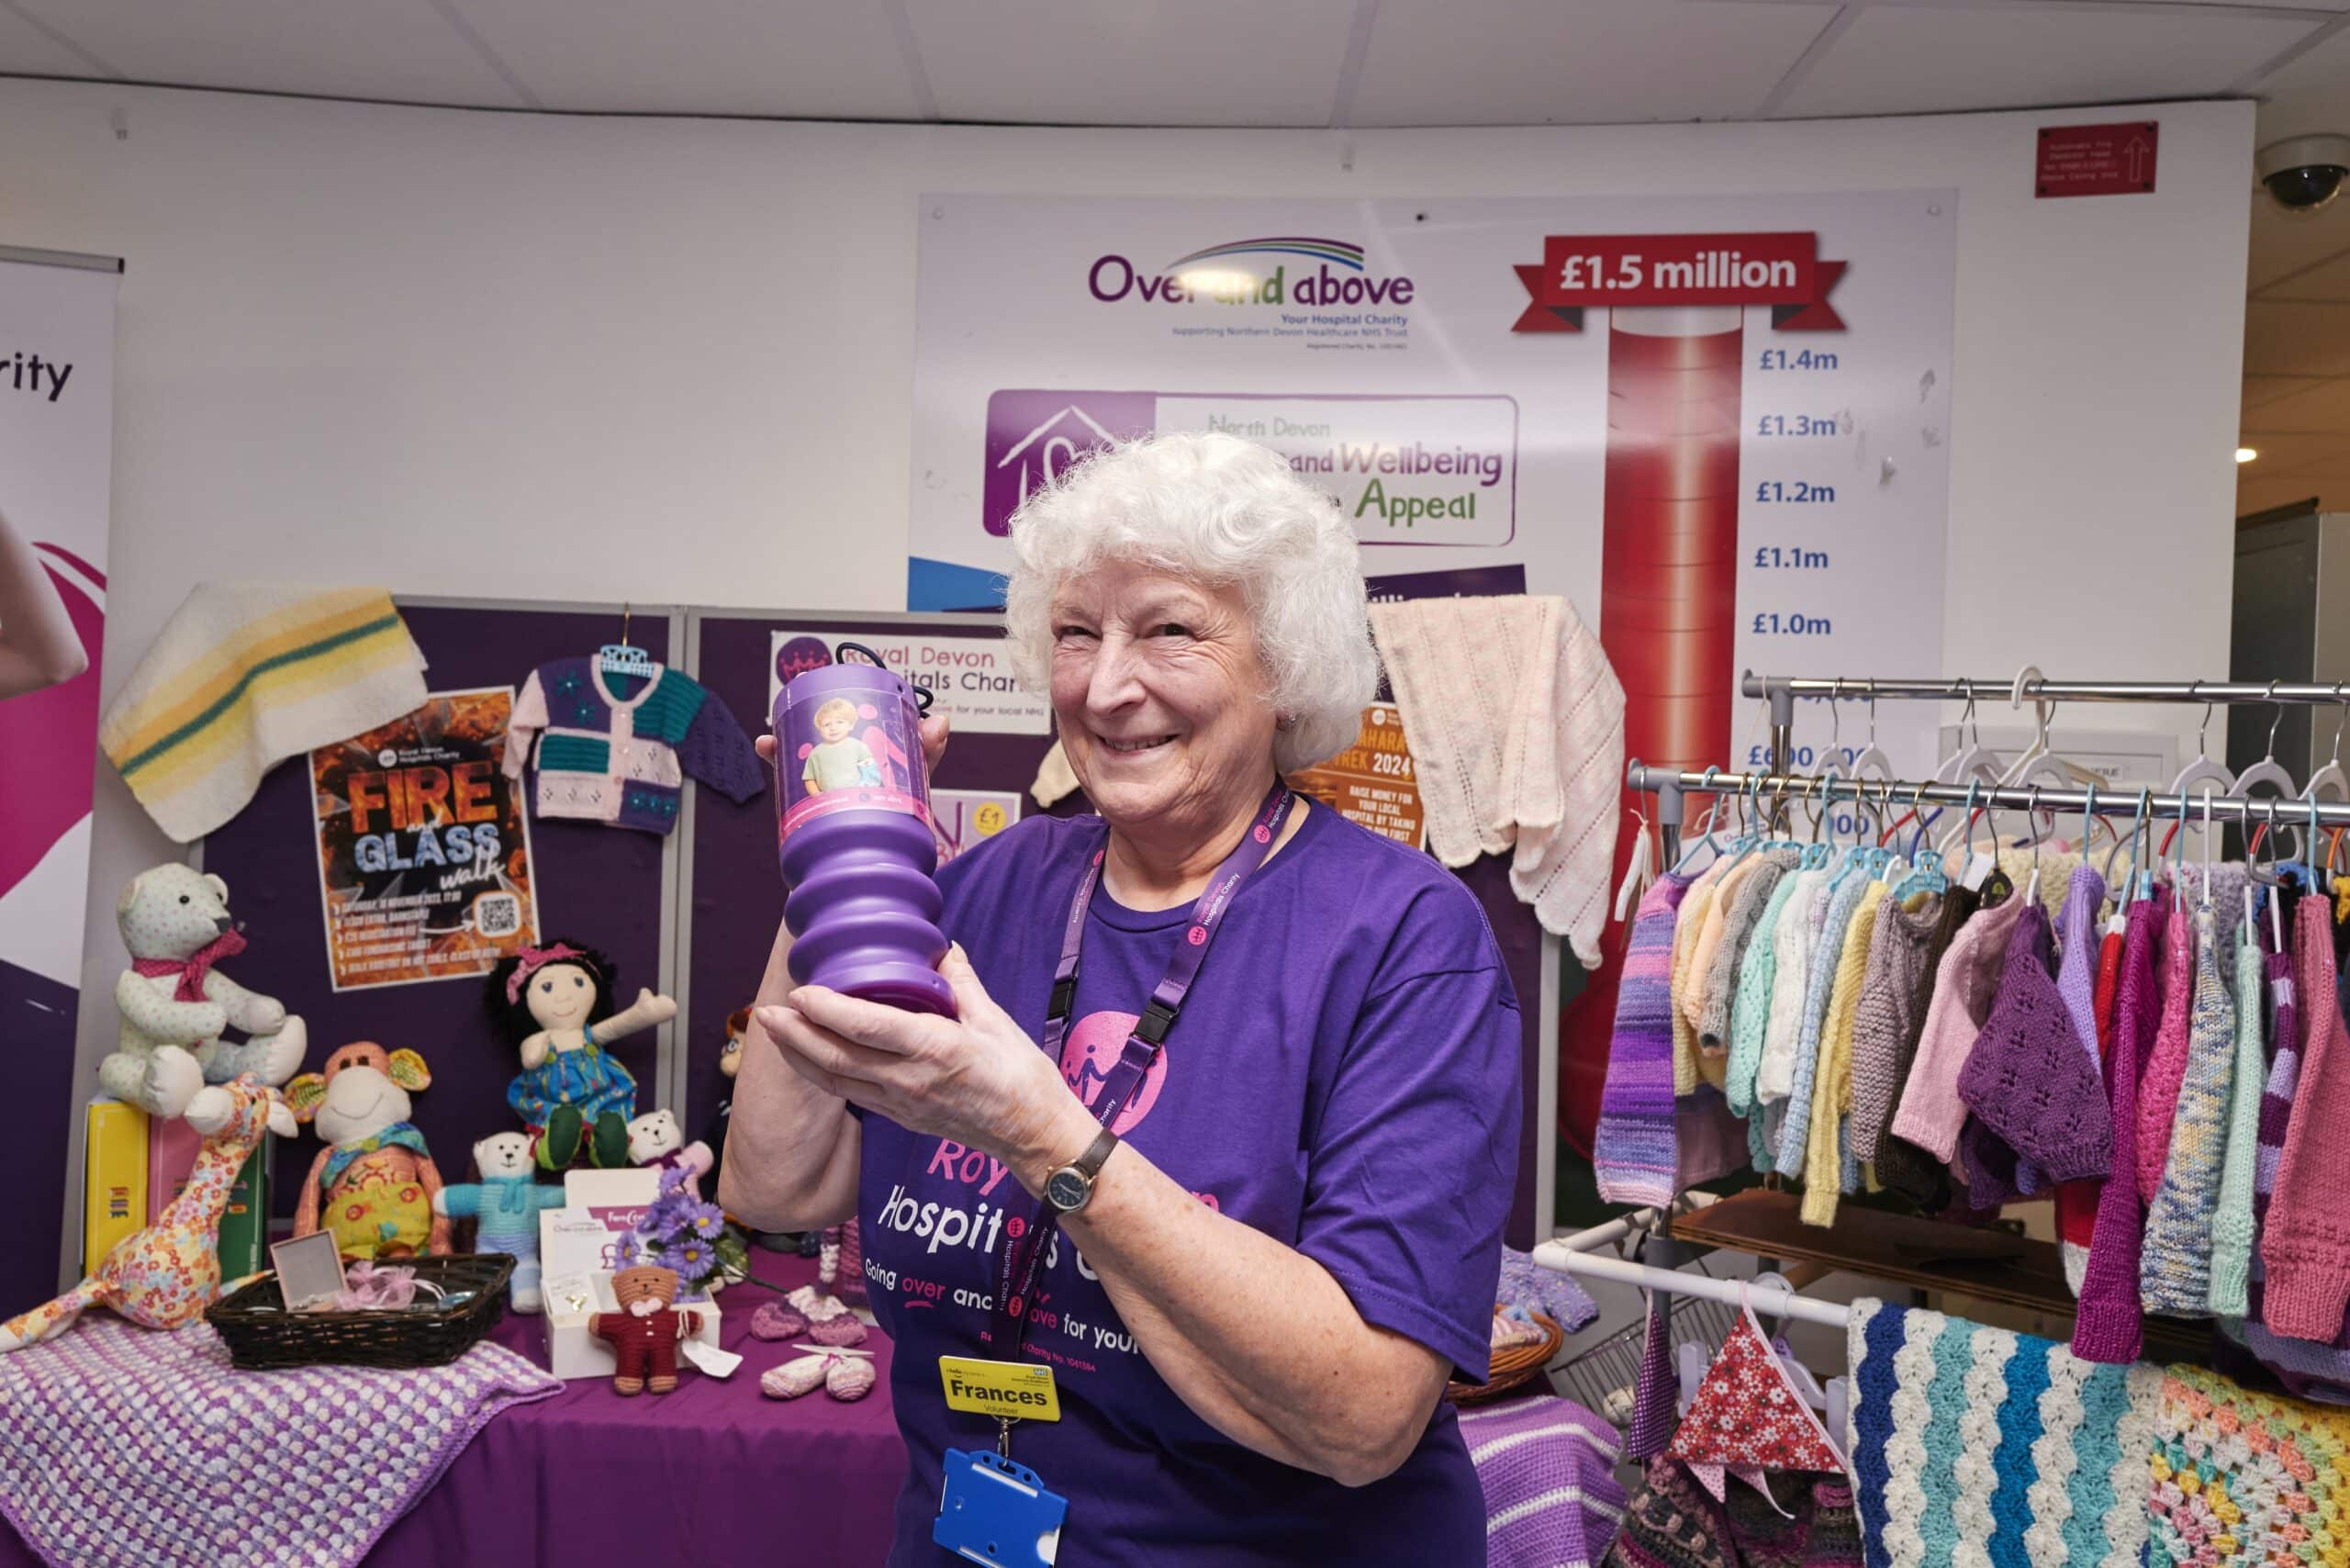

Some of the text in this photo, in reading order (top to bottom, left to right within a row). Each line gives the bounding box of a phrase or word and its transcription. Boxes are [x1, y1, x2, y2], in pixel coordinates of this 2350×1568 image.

[1561, 251, 1796, 289] £1.5 million
[1292, 264, 1414, 306] above
[1281, 314, 1408, 326] Your Hospital Charity
[1759, 350, 1838, 370] £1.4m
[1208, 414, 1331, 438] North Devon
[1758, 416, 1837, 436] £1.3m
[1289, 442, 1503, 487] and Wellbeing
[1354, 478, 1475, 527] Appeal
[1756, 482, 1835, 502] £1.2m
[1754, 547, 1830, 568] £1.1m
[1751, 613, 1831, 634] £1.0m
[921, 647, 995, 667] Devon
[903, 669, 1016, 693] itals Char
[1359, 728, 1406, 752] AHARA
[1372, 752, 1411, 776] 2024
[348, 761, 498, 834] FIRE
[979, 807, 1000, 825] £1
[354, 823, 501, 873] GLASS
[440, 844, 506, 890] walk
[1100, 1098, 1116, 1125] harity
[927, 1137, 1010, 1197] Roy
[878, 1184, 1060, 1270] Hospits
[865, 1258, 897, 1291] Going
[902, 1277, 946, 1301] over
[1029, 1306, 1058, 1329] ove
[1063, 1313, 1088, 1340] for
[950, 1379, 1047, 1406] Frances
